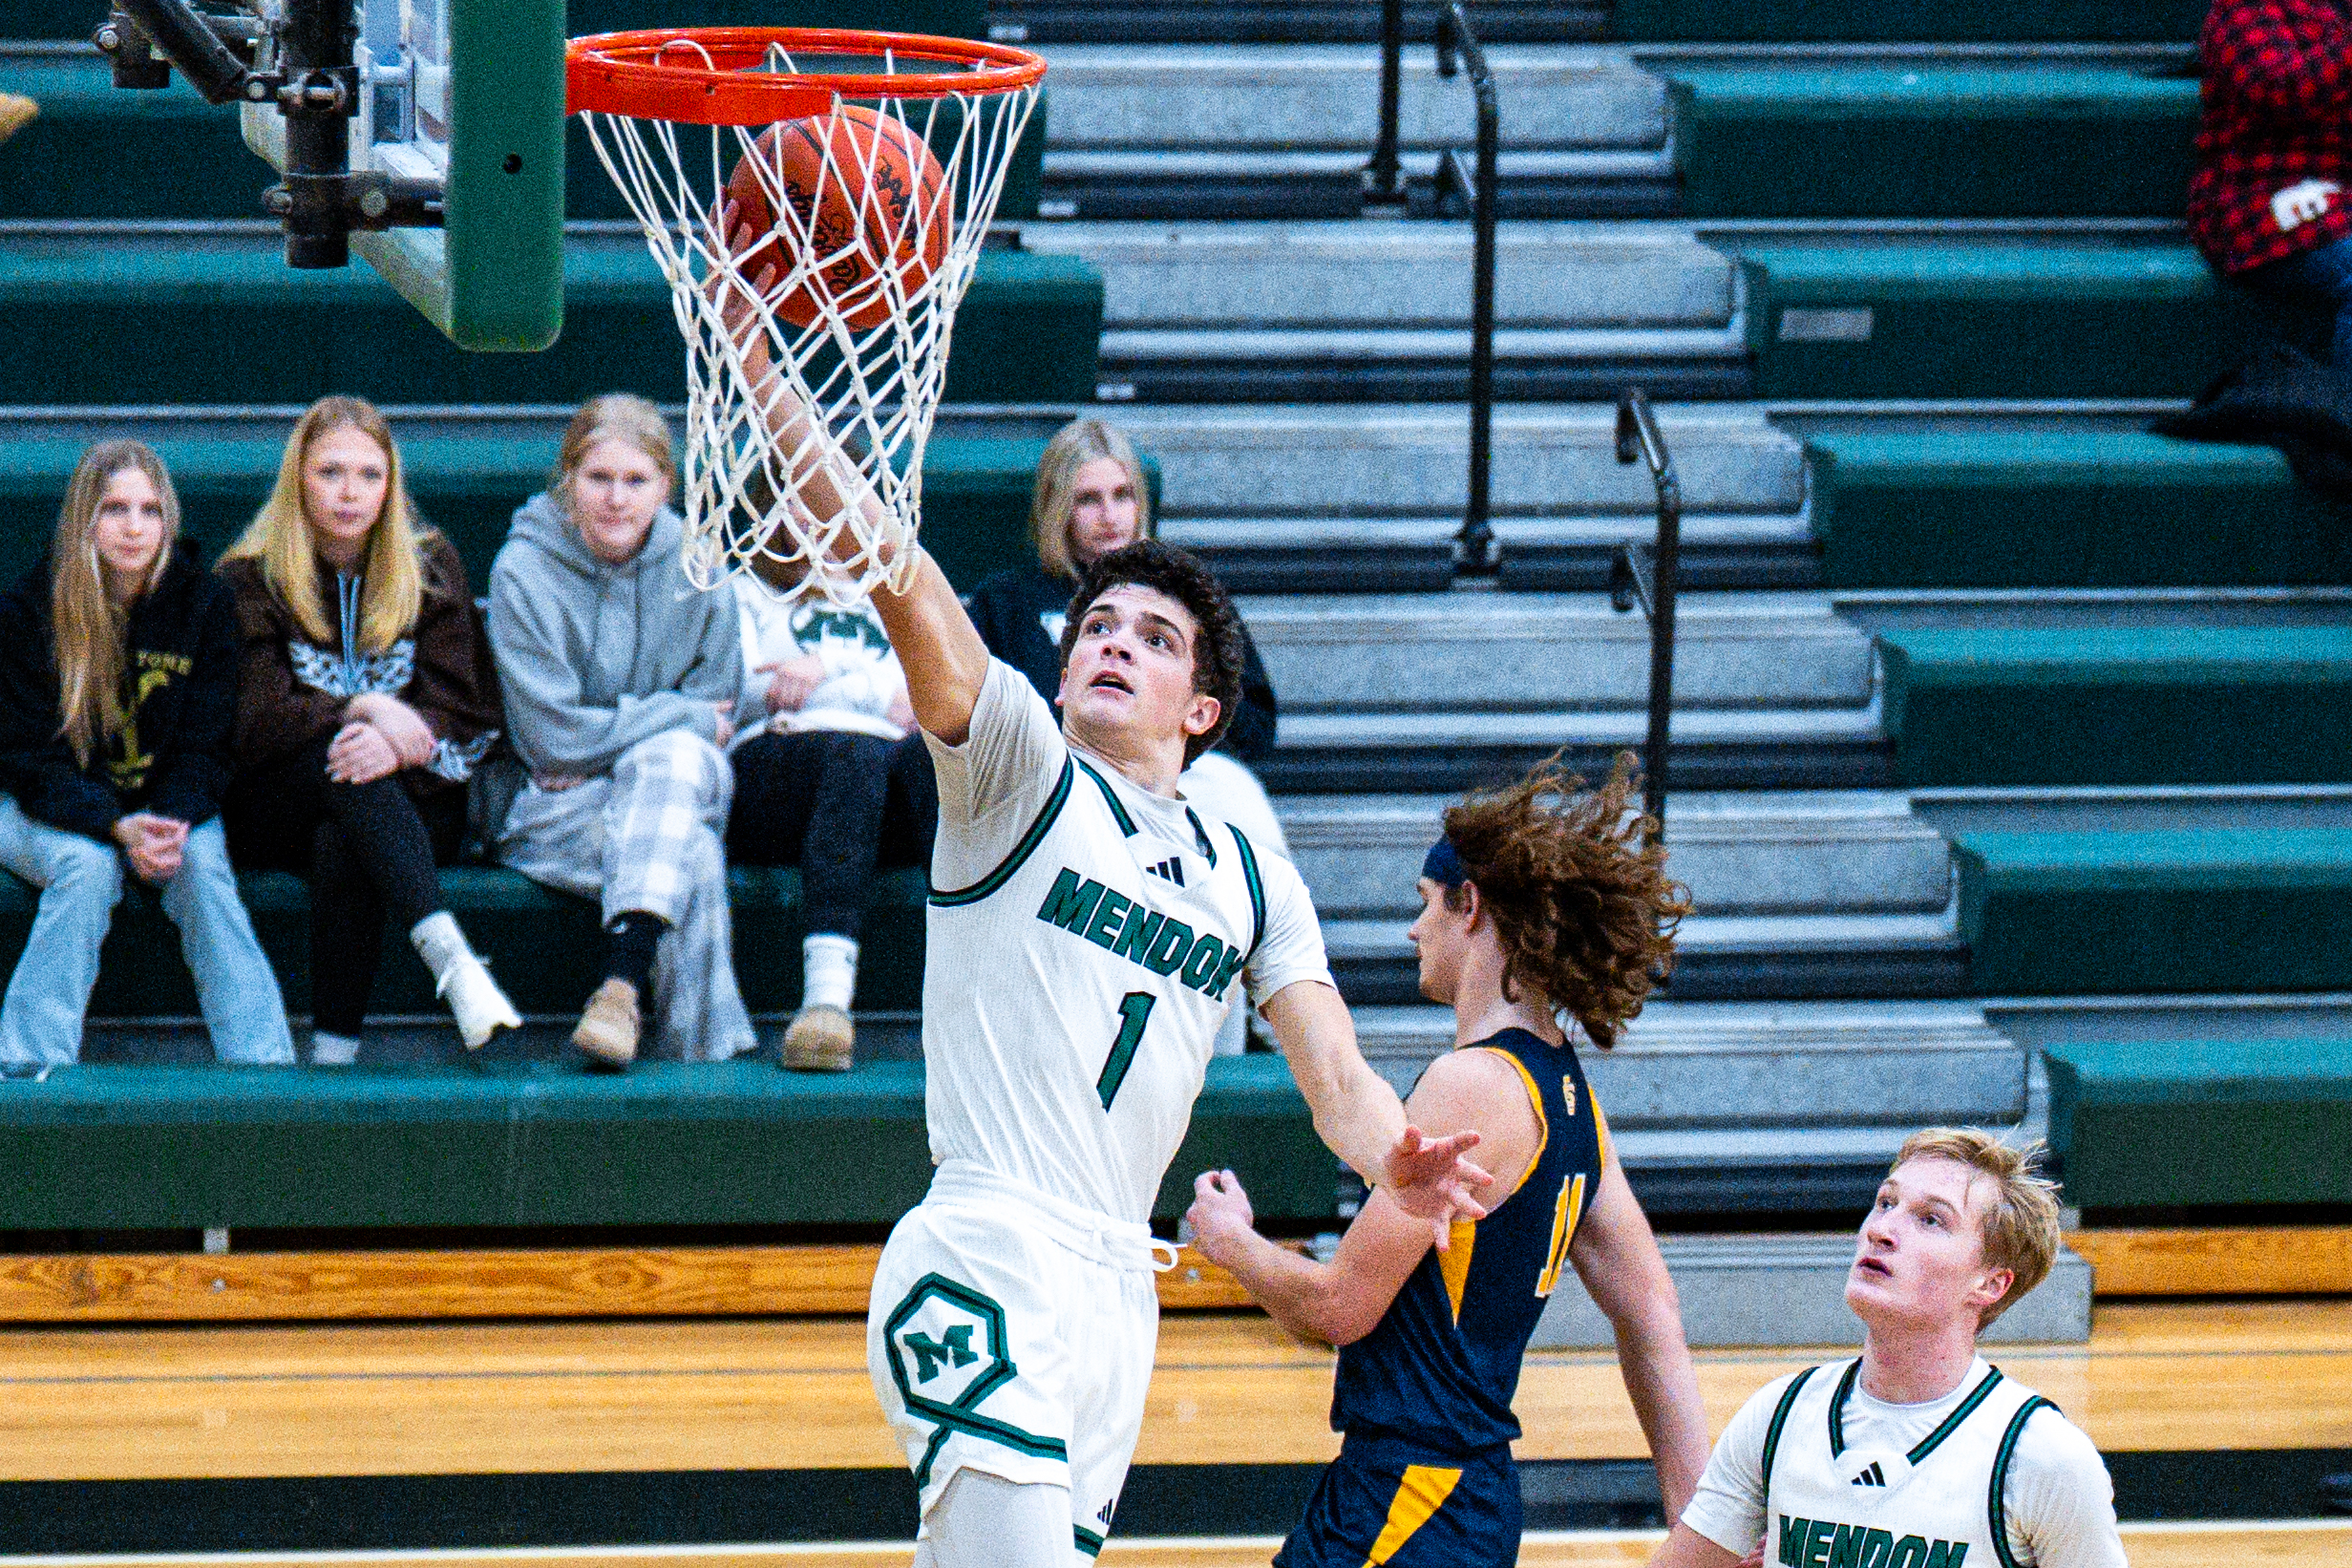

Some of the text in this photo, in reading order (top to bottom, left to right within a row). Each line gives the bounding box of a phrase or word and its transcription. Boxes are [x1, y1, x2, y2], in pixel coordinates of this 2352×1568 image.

[1095, 990, 1157, 1114] 1
[903, 1324, 979, 1386] M
[1779, 1514, 1970, 1568] MENDON
